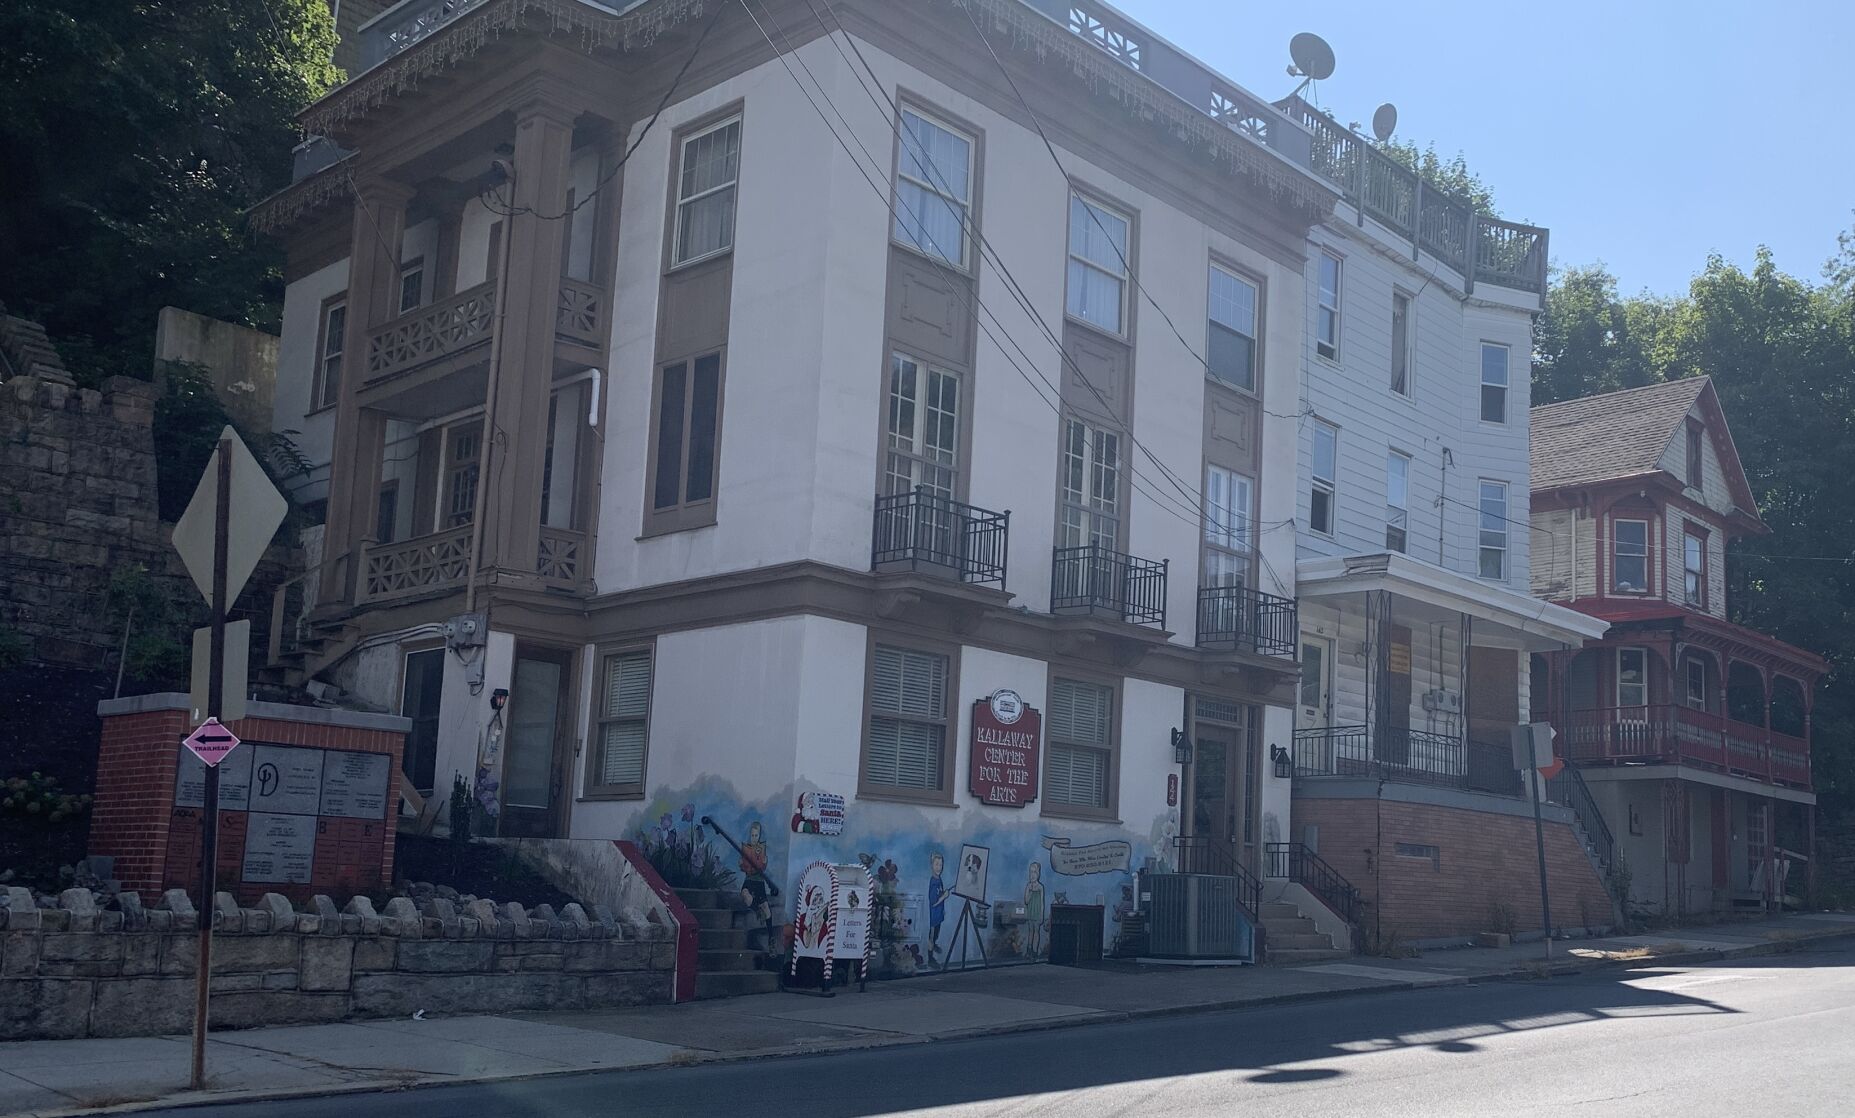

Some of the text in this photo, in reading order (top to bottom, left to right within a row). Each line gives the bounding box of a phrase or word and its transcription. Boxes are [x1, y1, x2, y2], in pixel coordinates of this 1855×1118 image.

[977, 726, 1034, 750] KALLAWAY
[984, 747, 1026, 767] CENTER
[979, 765, 1029, 786] FOR THE
[989, 785, 1017, 803] ARTS
[819, 808, 842, 817] Santa
[846, 930, 856, 938] For
[842, 941, 858, 949] Santa
